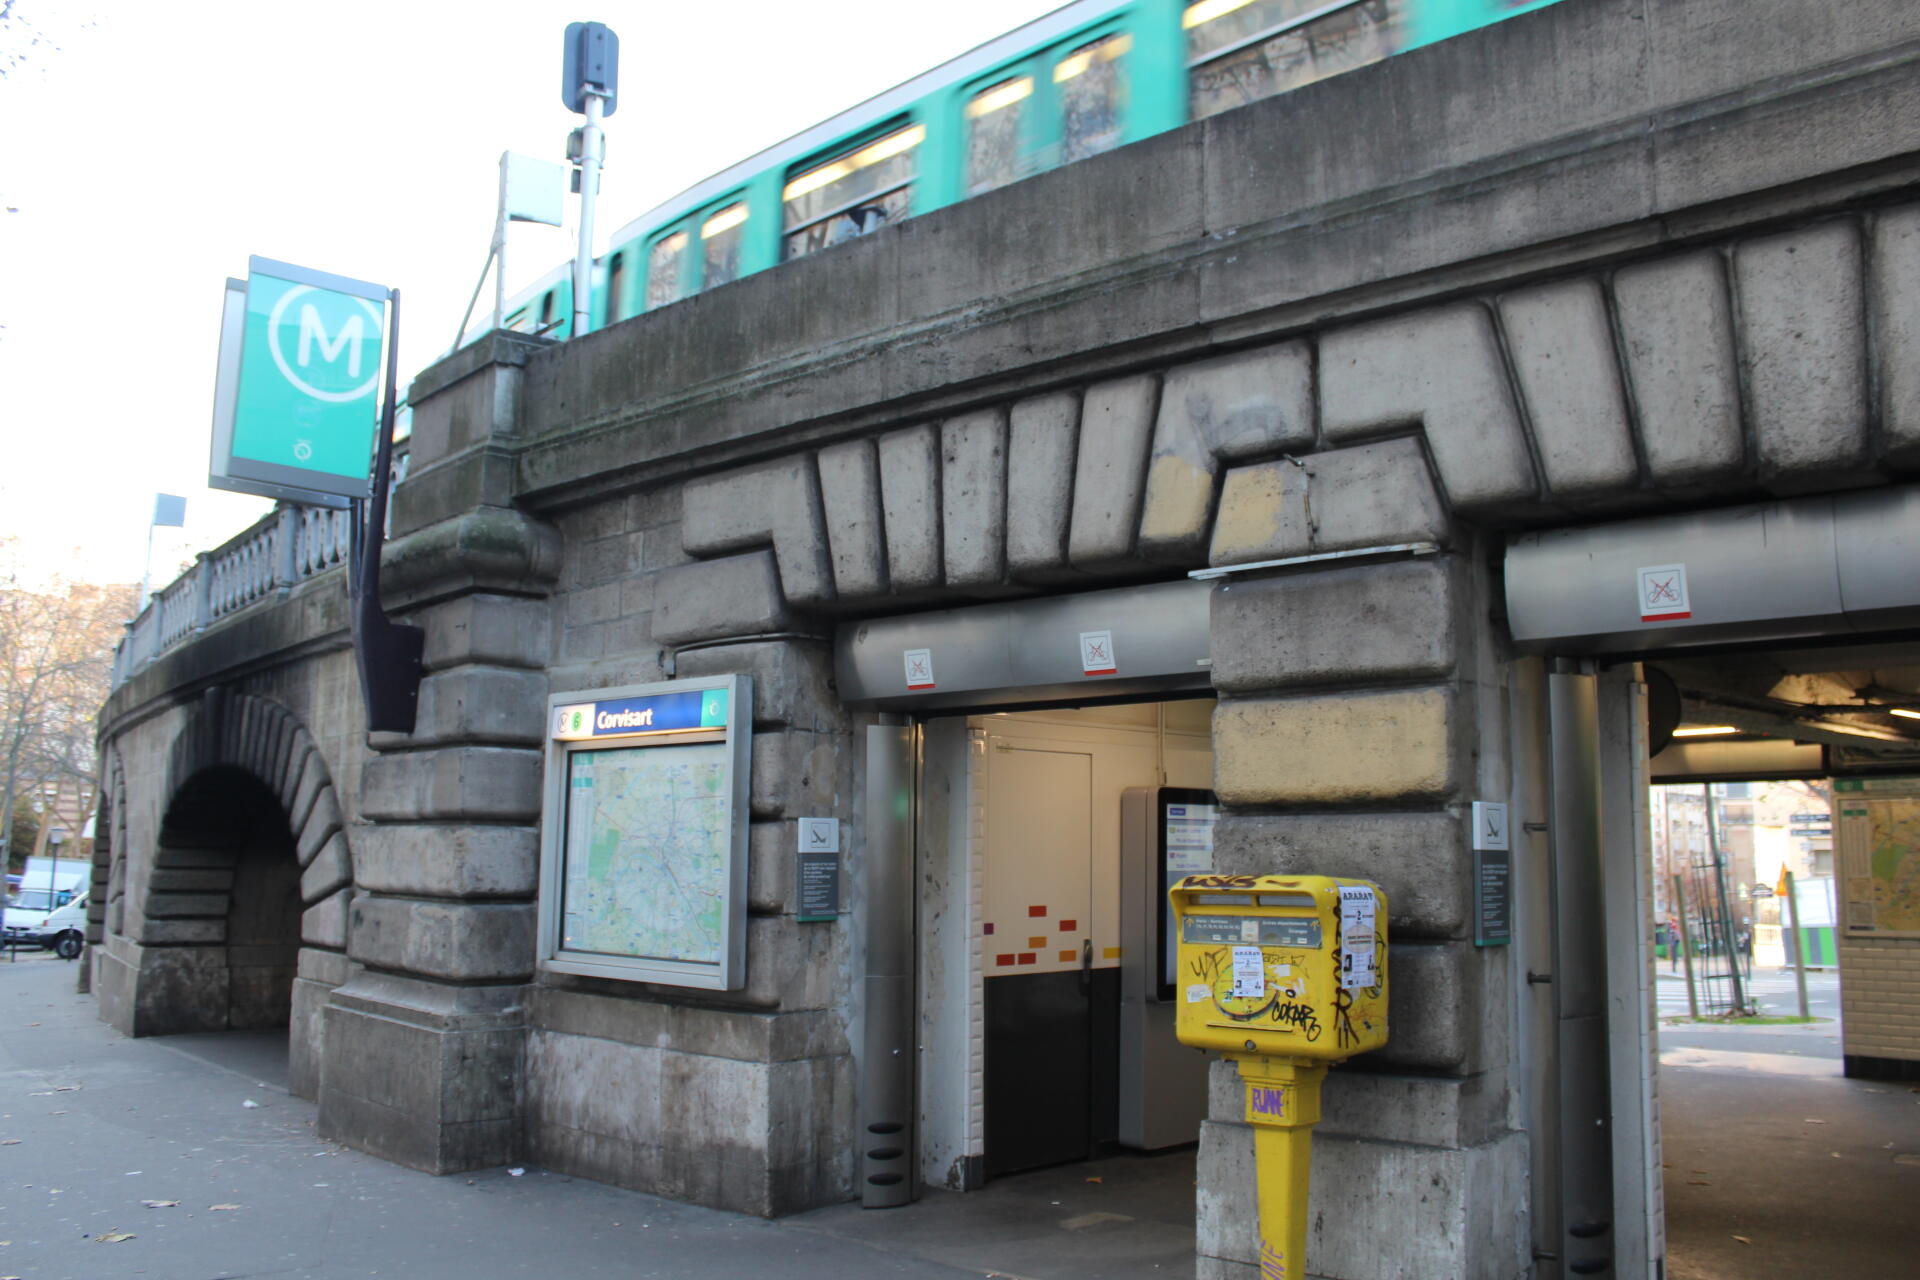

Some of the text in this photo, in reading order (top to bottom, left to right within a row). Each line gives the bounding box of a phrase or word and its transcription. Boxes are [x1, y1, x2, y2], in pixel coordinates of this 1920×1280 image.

[296, 303, 365, 379] M
[597, 709, 653, 729] Corvisart
[1343, 892, 1373, 901] ARARAT
[1357, 910, 1362, 920] 2
